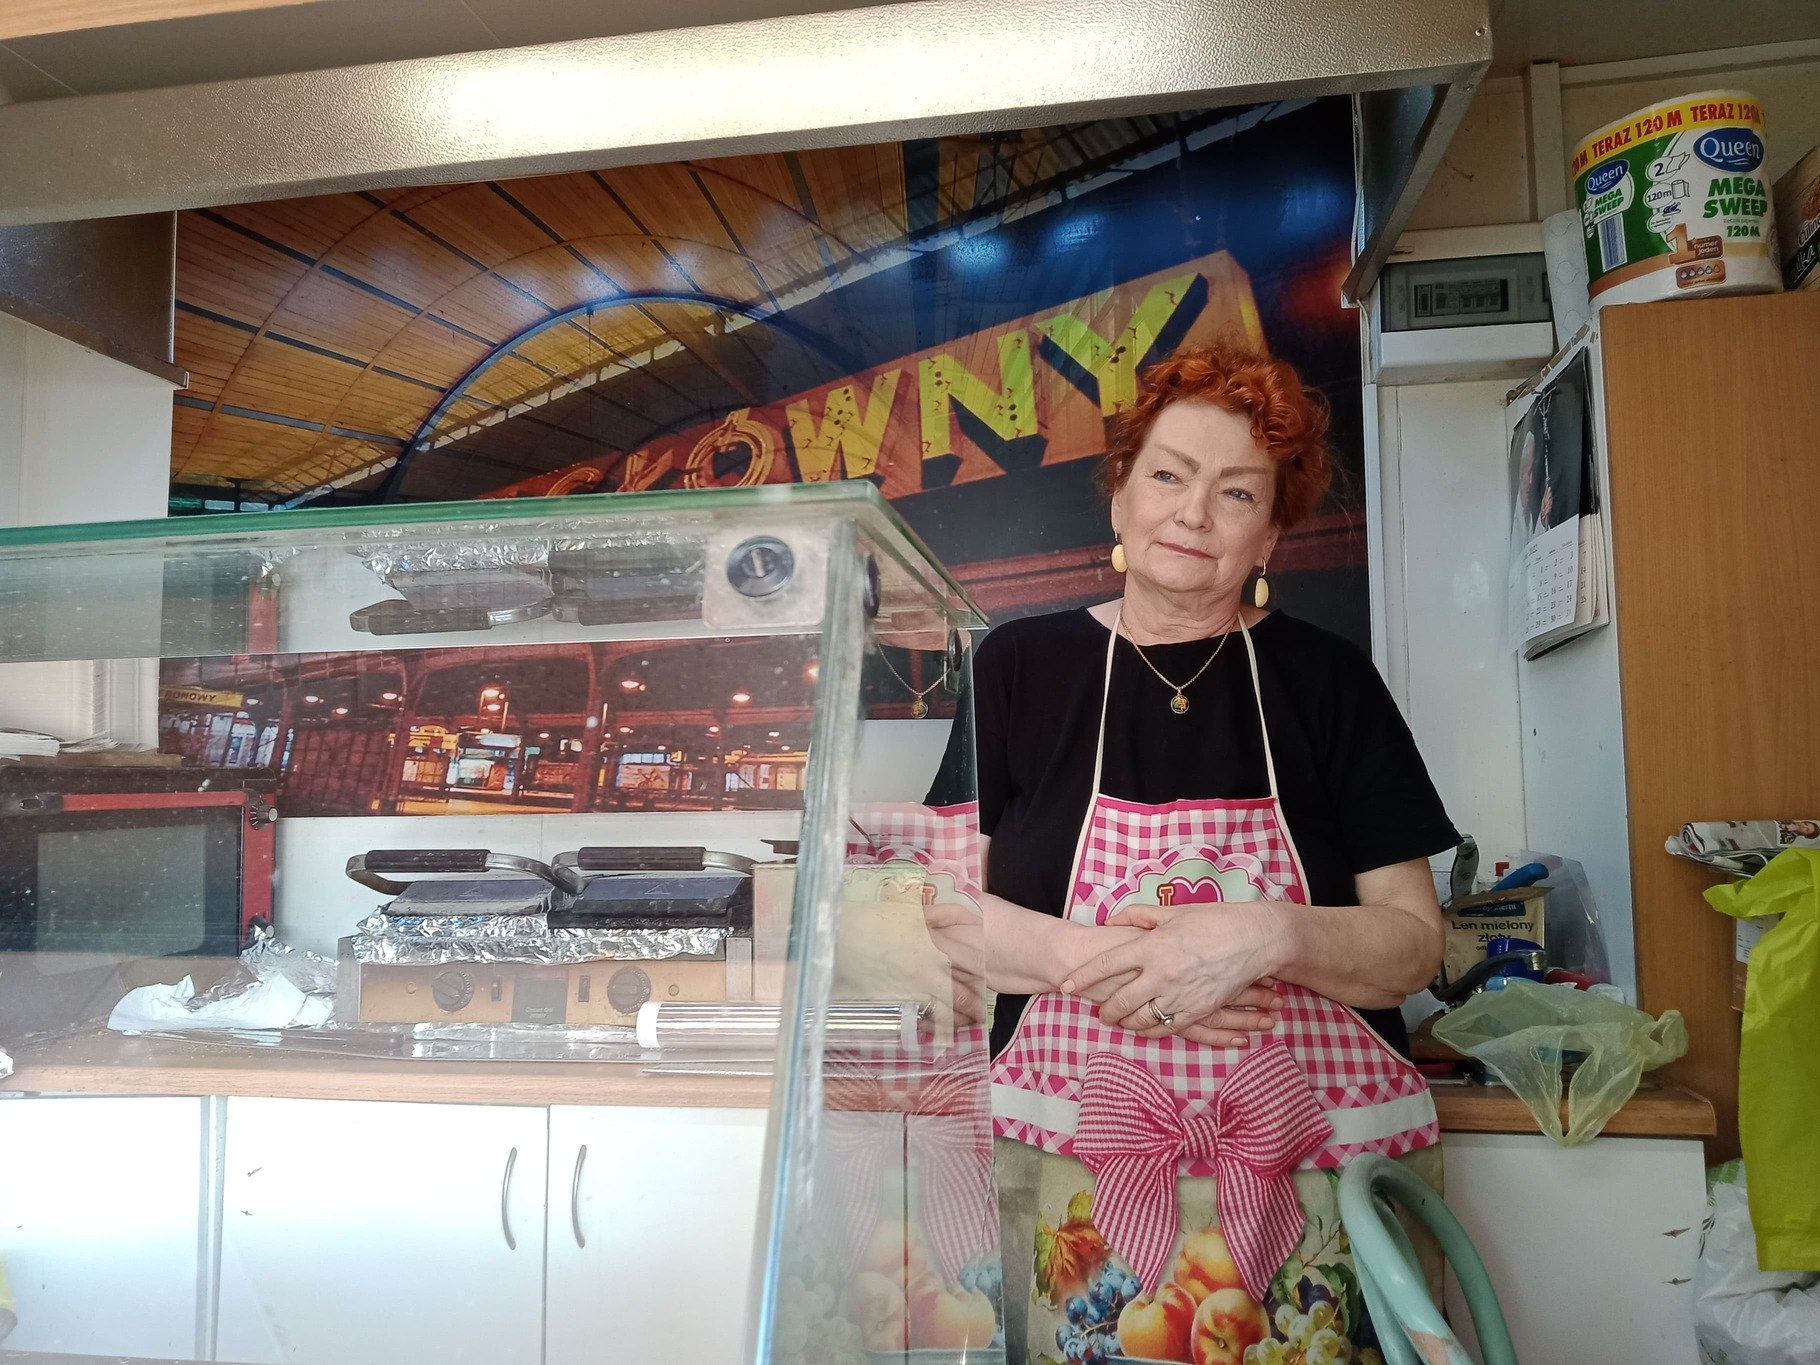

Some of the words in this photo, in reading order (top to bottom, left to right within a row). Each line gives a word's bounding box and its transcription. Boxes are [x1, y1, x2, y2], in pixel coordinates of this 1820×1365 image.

[1592, 126, 1632, 159] TERAZ
[1635, 116, 1664, 138] 120
[1667, 110, 1683, 128] M
[1690, 103, 1735, 122] TERAZ
[1699, 137, 1760, 162] Queen
[1587, 165, 1624, 191] Queen
[1654, 162, 1665, 177] 2
[1707, 177, 1766, 197] MEGA
[1594, 188, 1623, 208] MEGA
[1594, 196, 1624, 219] SWEEP
[1703, 197, 1767, 218] SWEEP
[1727, 225, 1748, 237] 120
[1694, 240, 1718, 250] numer
[1698, 246, 1719, 256] jeden
[1452, 920, 1478, 930] Len
[1481, 920, 1534, 932] mielony
